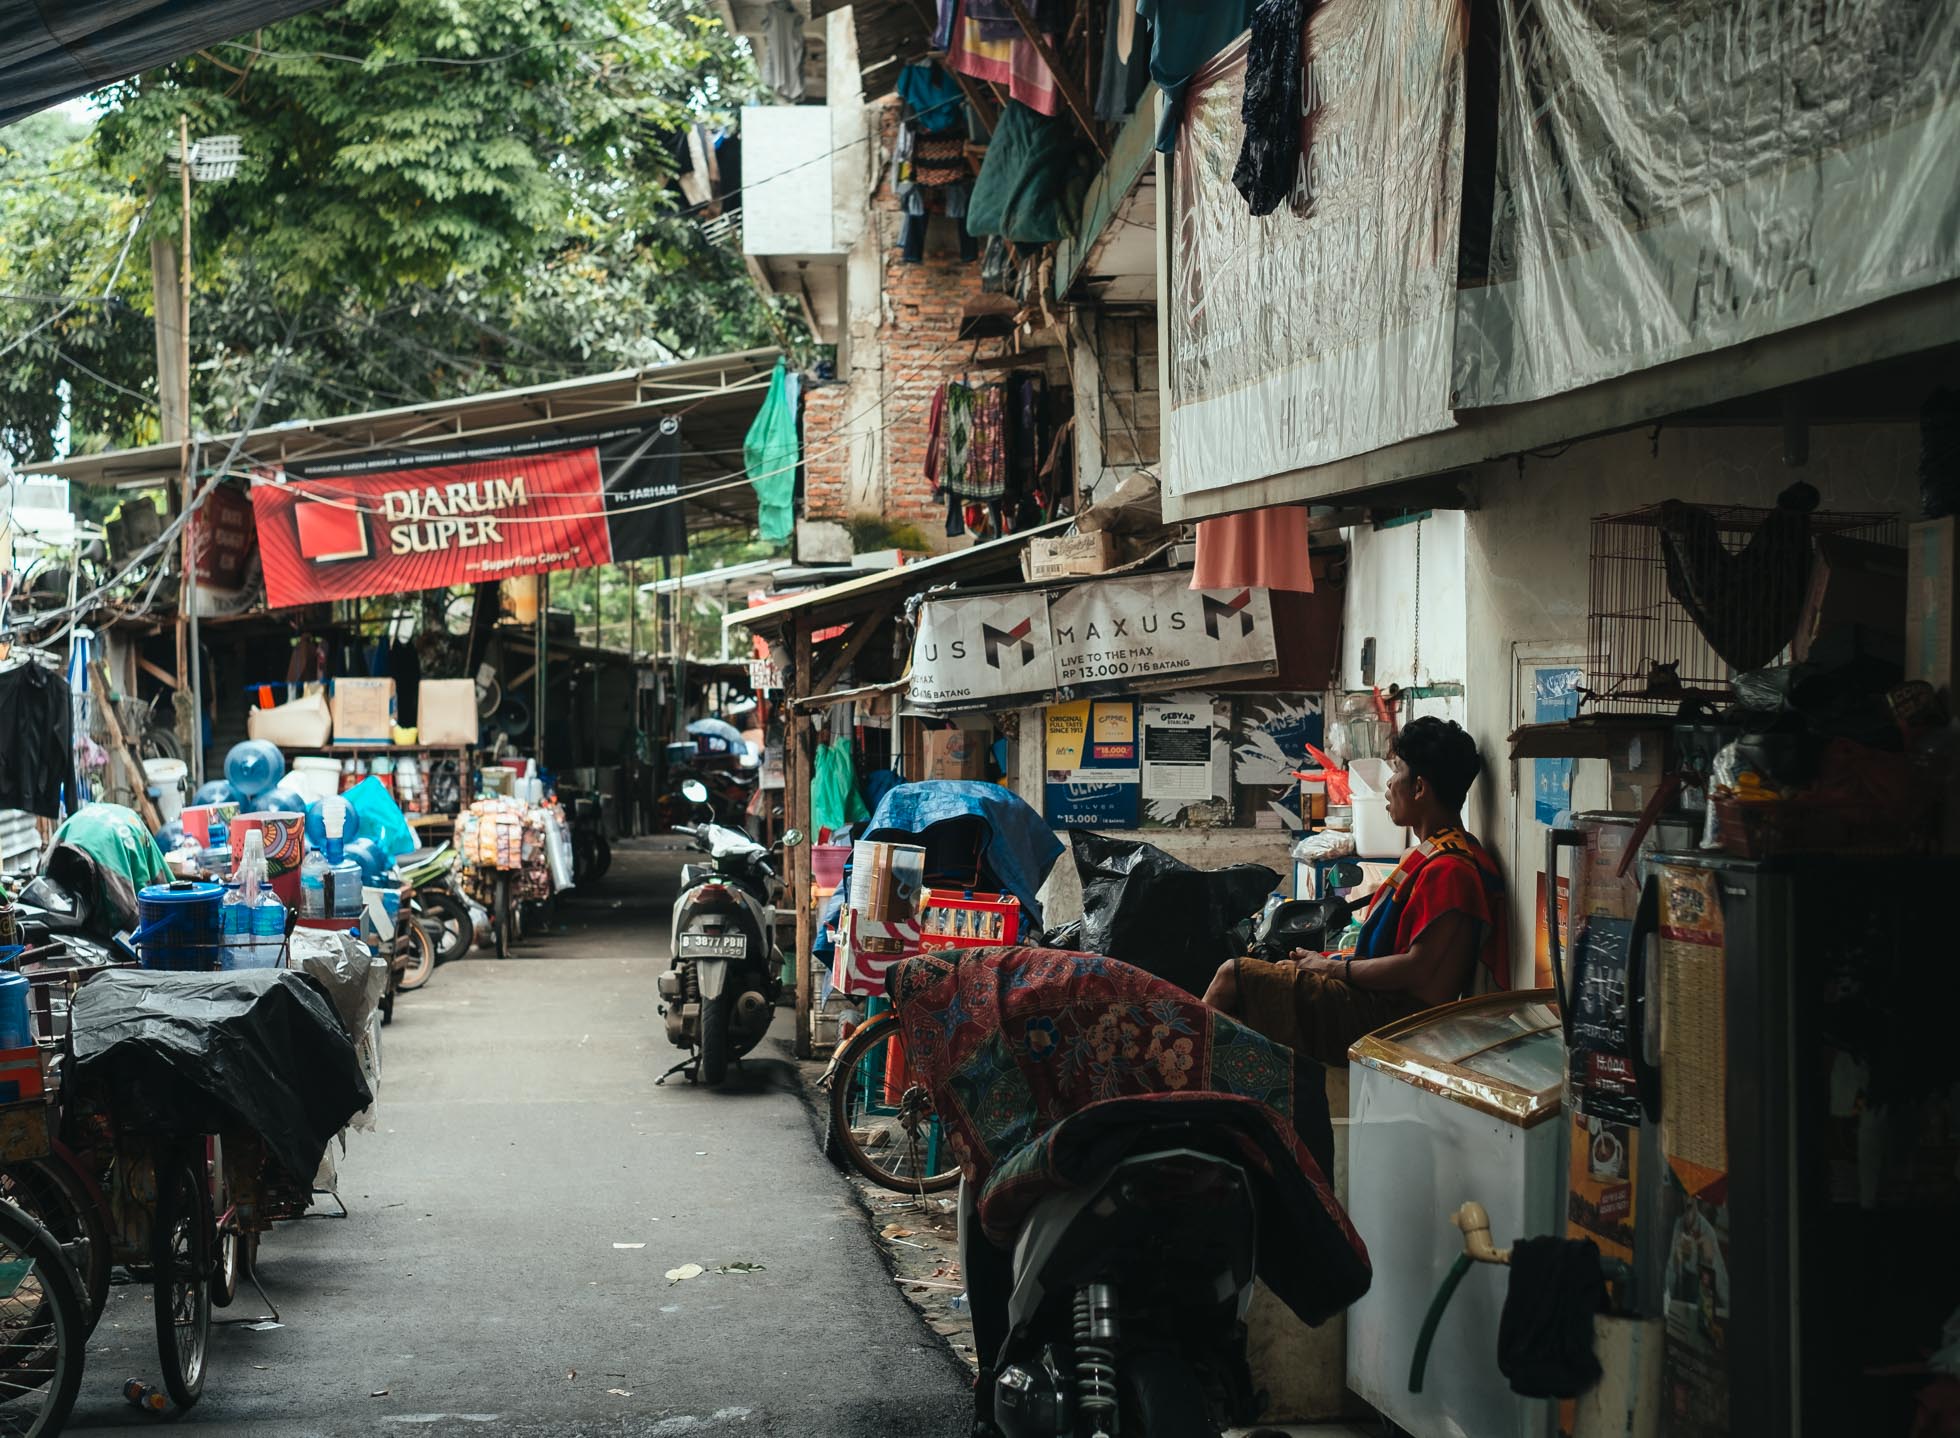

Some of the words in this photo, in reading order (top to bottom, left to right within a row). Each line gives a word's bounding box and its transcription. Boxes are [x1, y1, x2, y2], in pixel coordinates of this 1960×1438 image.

[383, 476, 528, 522] DJARUM
[390, 515, 505, 555] SUPER
[1056, 612, 1186, 646] MAXUS
[1061, 655, 1084, 667] LIVE
[1087, 653, 1102, 662] TO
[1105, 650, 1126, 660] THE
[1129, 646, 1154, 657] MAX
[1062, 669, 1076, 678] RP
[1079, 662, 1129, 678] 13.000
[1139, 662, 1150, 672] 16
[1152, 659, 1191, 670] BATANG
[934, 688, 971, 699] BATANG
[1065, 814, 1098, 823] 15.000
